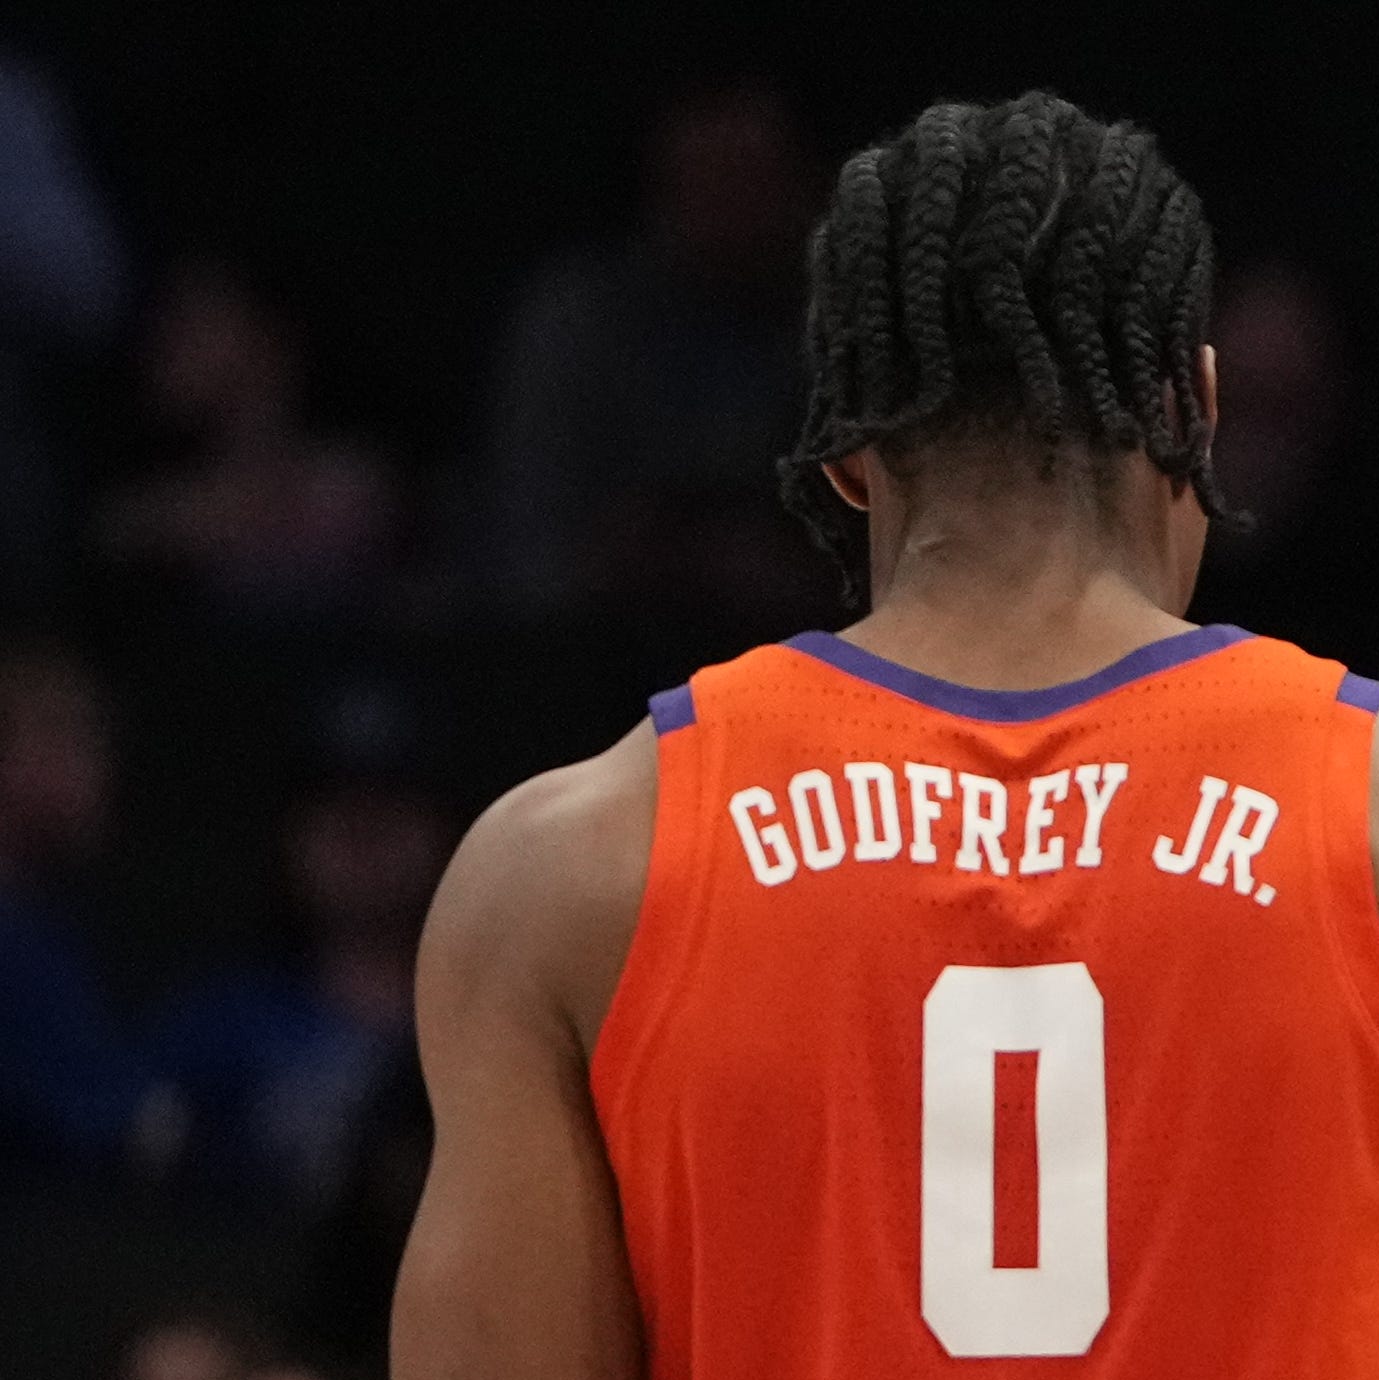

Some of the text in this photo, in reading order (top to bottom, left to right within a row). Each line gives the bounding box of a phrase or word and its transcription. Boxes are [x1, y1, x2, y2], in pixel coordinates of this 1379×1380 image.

[728, 761, 1280, 907] GODFREY JR.
[921, 961, 1110, 1358] 0
